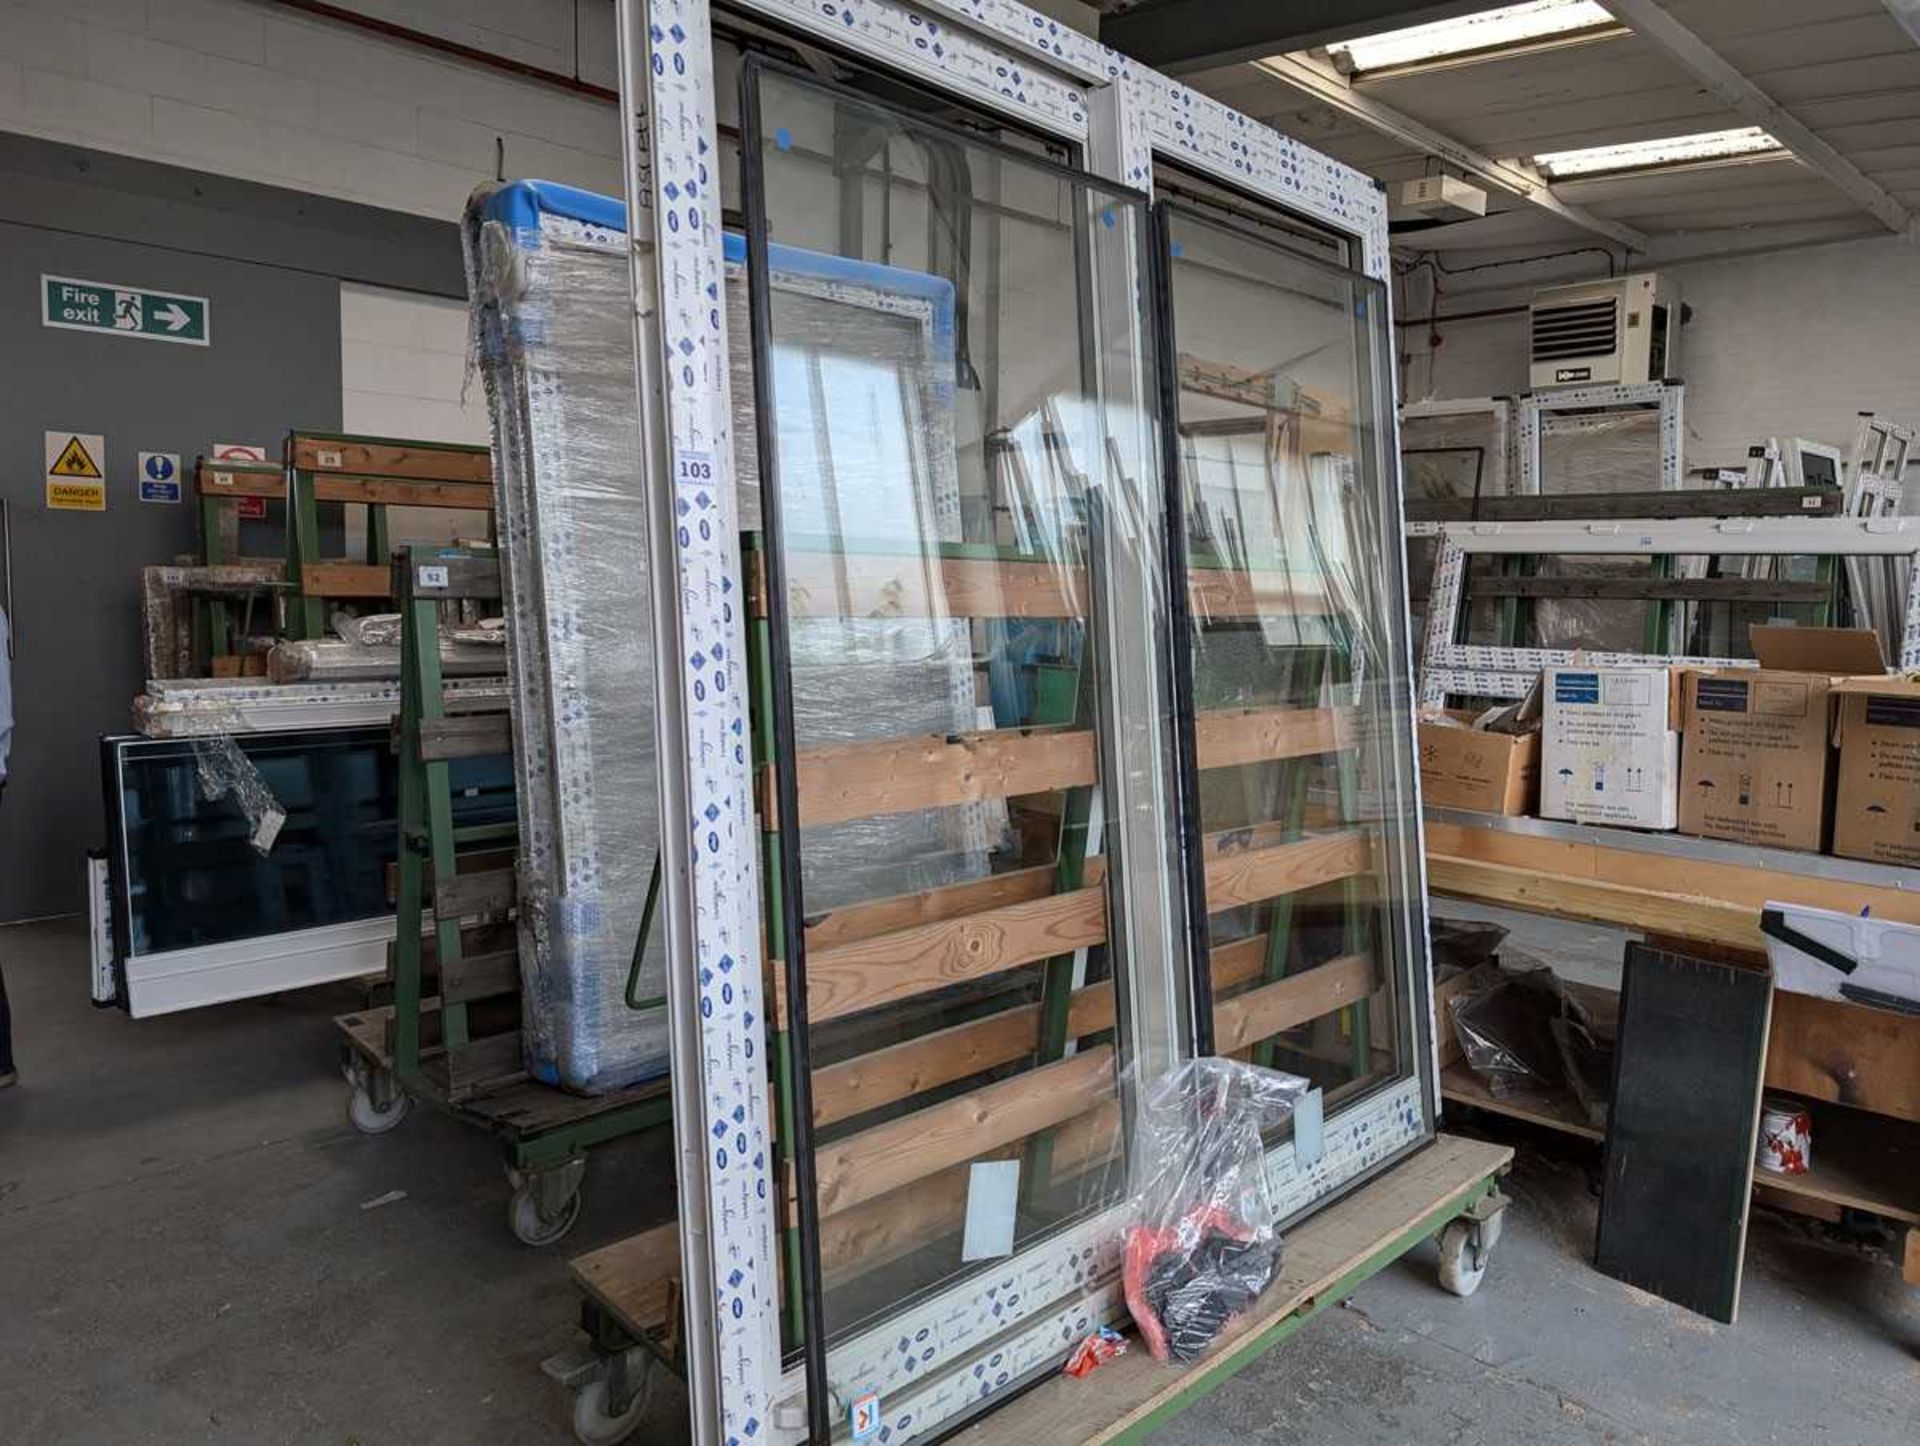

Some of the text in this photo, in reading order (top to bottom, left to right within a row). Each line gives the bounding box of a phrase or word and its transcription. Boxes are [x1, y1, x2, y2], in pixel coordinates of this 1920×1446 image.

[62, 286, 100, 305] Fire
[63, 307, 100, 322] exit
[680, 461, 711, 479] 103
[53, 486, 99, 497] DANGER
